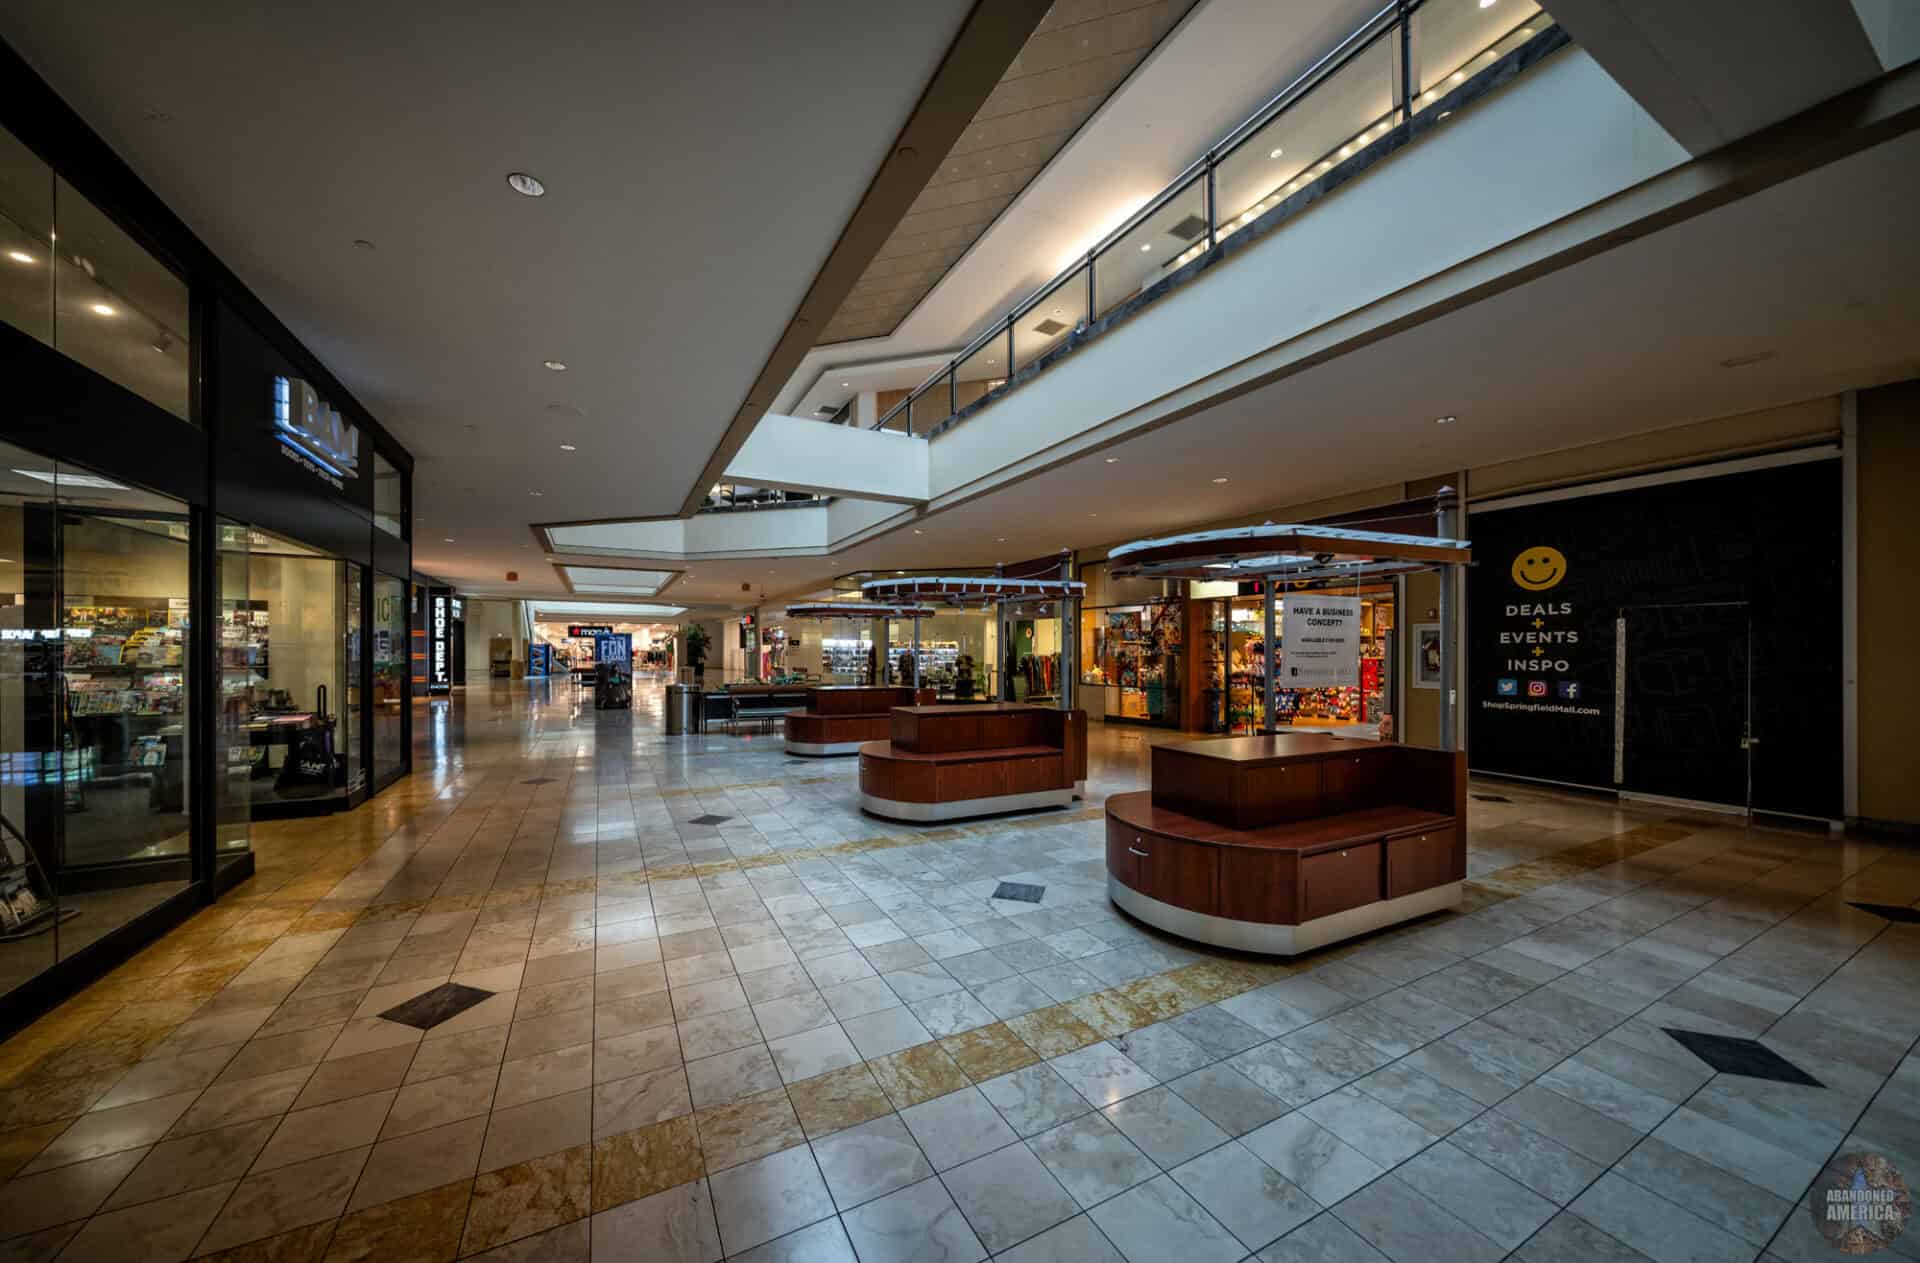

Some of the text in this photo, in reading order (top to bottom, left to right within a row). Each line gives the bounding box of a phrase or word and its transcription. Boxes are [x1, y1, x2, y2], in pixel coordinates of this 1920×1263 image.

[1293, 607, 1313, 616] HAVE
[1505, 602, 1573, 616] DEALS
[1500, 631, 1579, 644] EVENTS
[1507, 659, 1570, 672] INSPO
